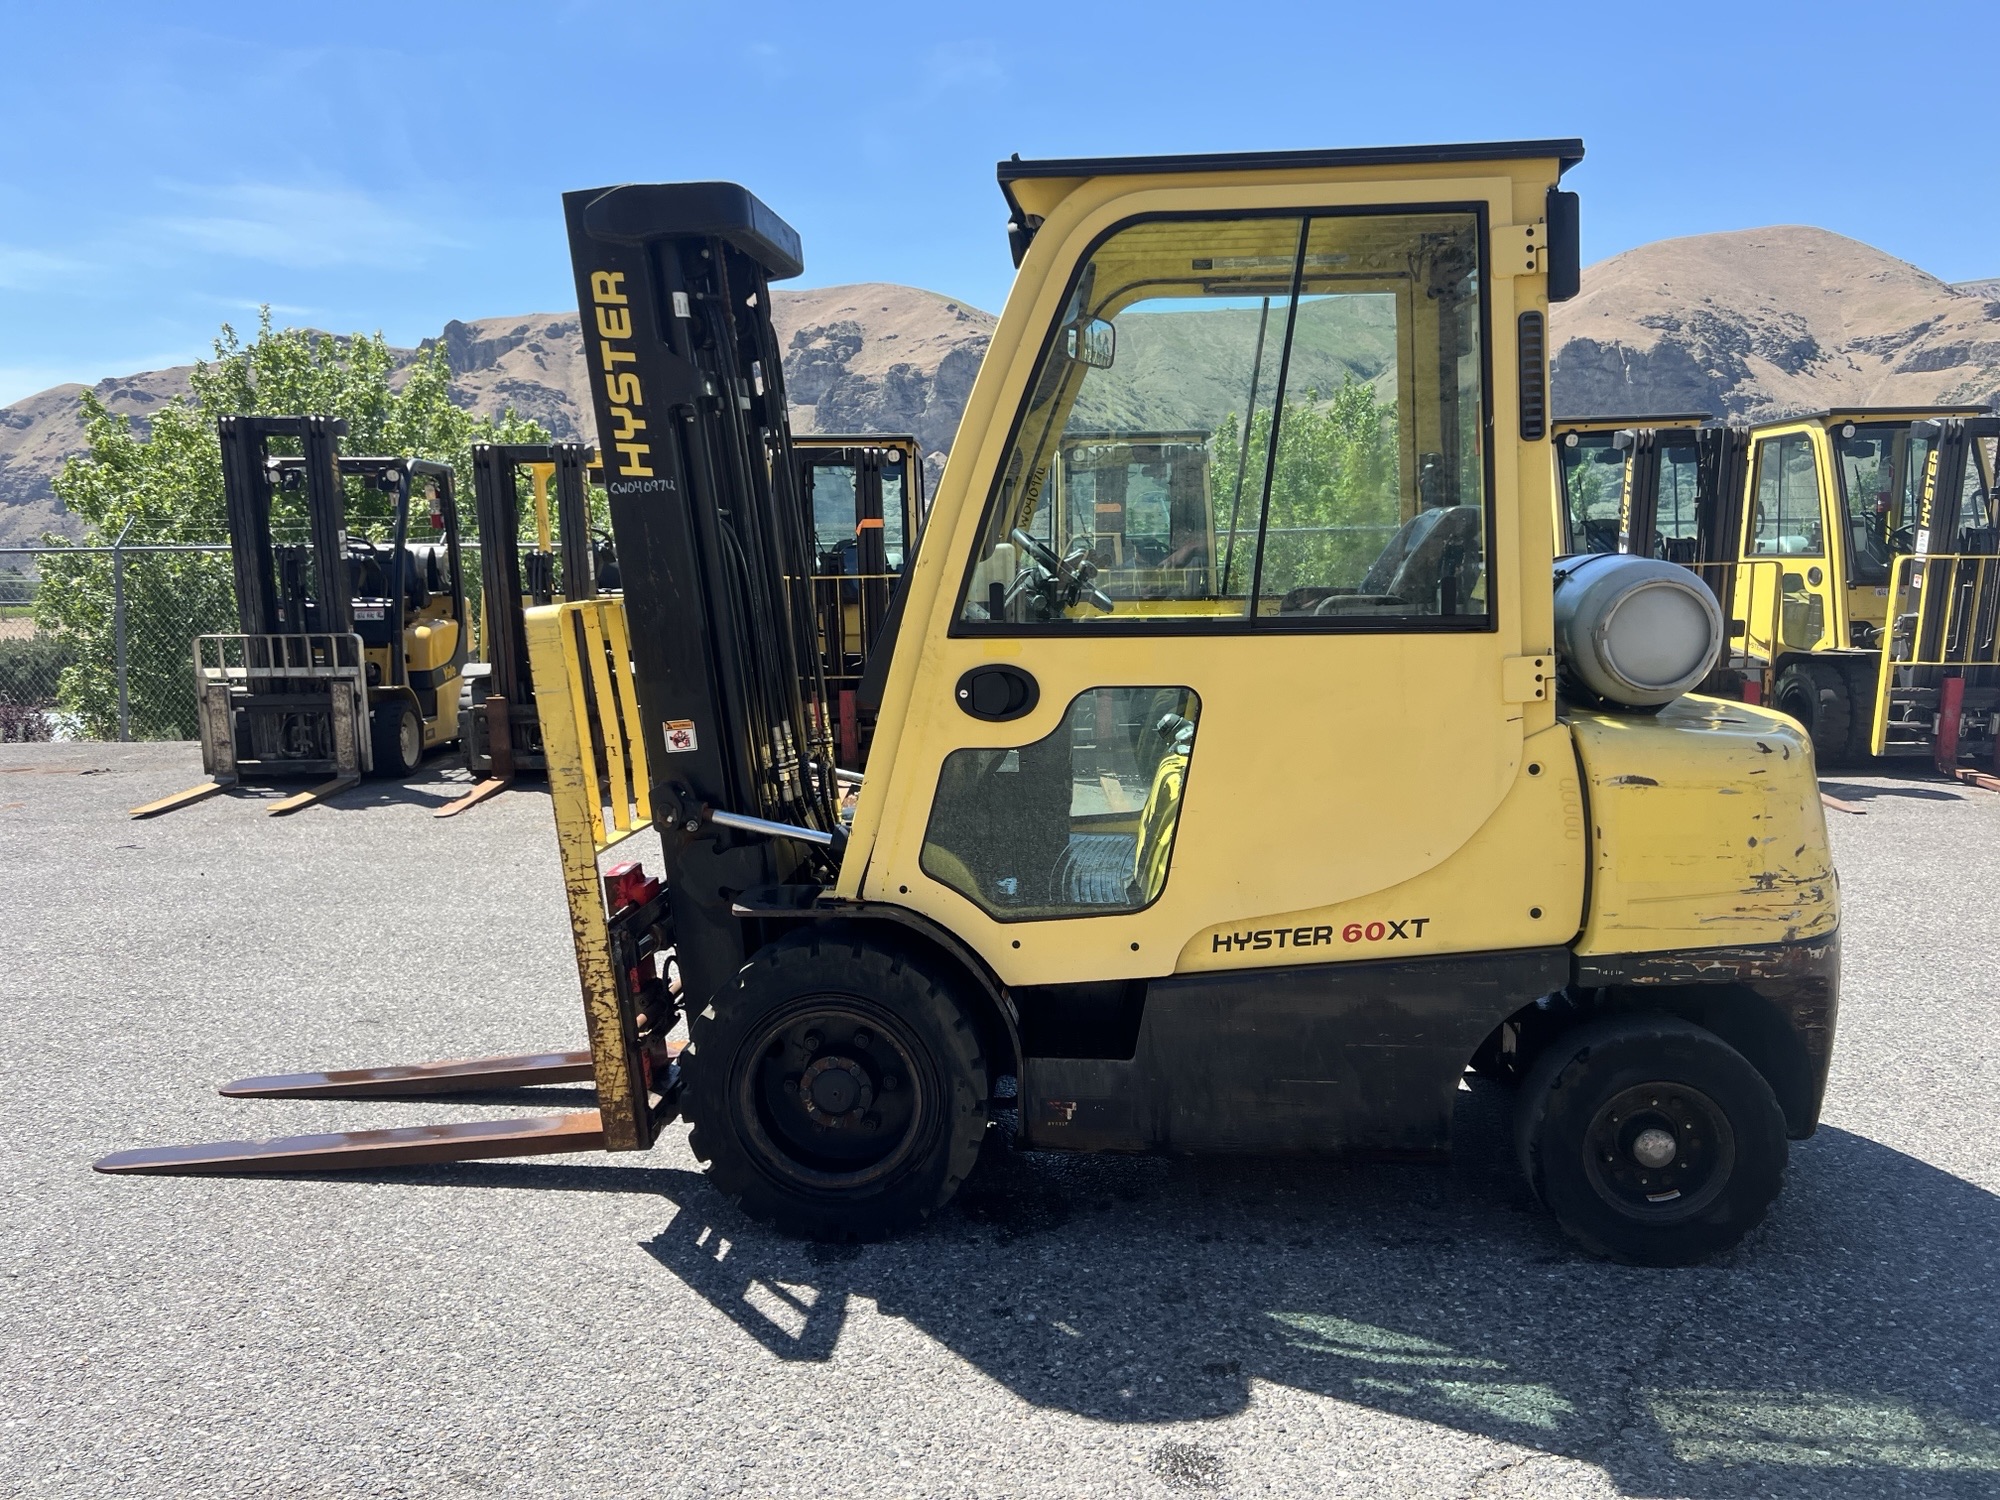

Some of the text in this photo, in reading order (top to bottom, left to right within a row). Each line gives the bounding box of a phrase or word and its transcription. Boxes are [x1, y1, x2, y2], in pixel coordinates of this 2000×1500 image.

[590, 271, 654, 476] HYSTER
[1621, 456, 1633, 533] HYSTER
[1920, 450, 1939, 528] HYSTER
[1212, 918, 1430, 953] HYSTER 60XT
